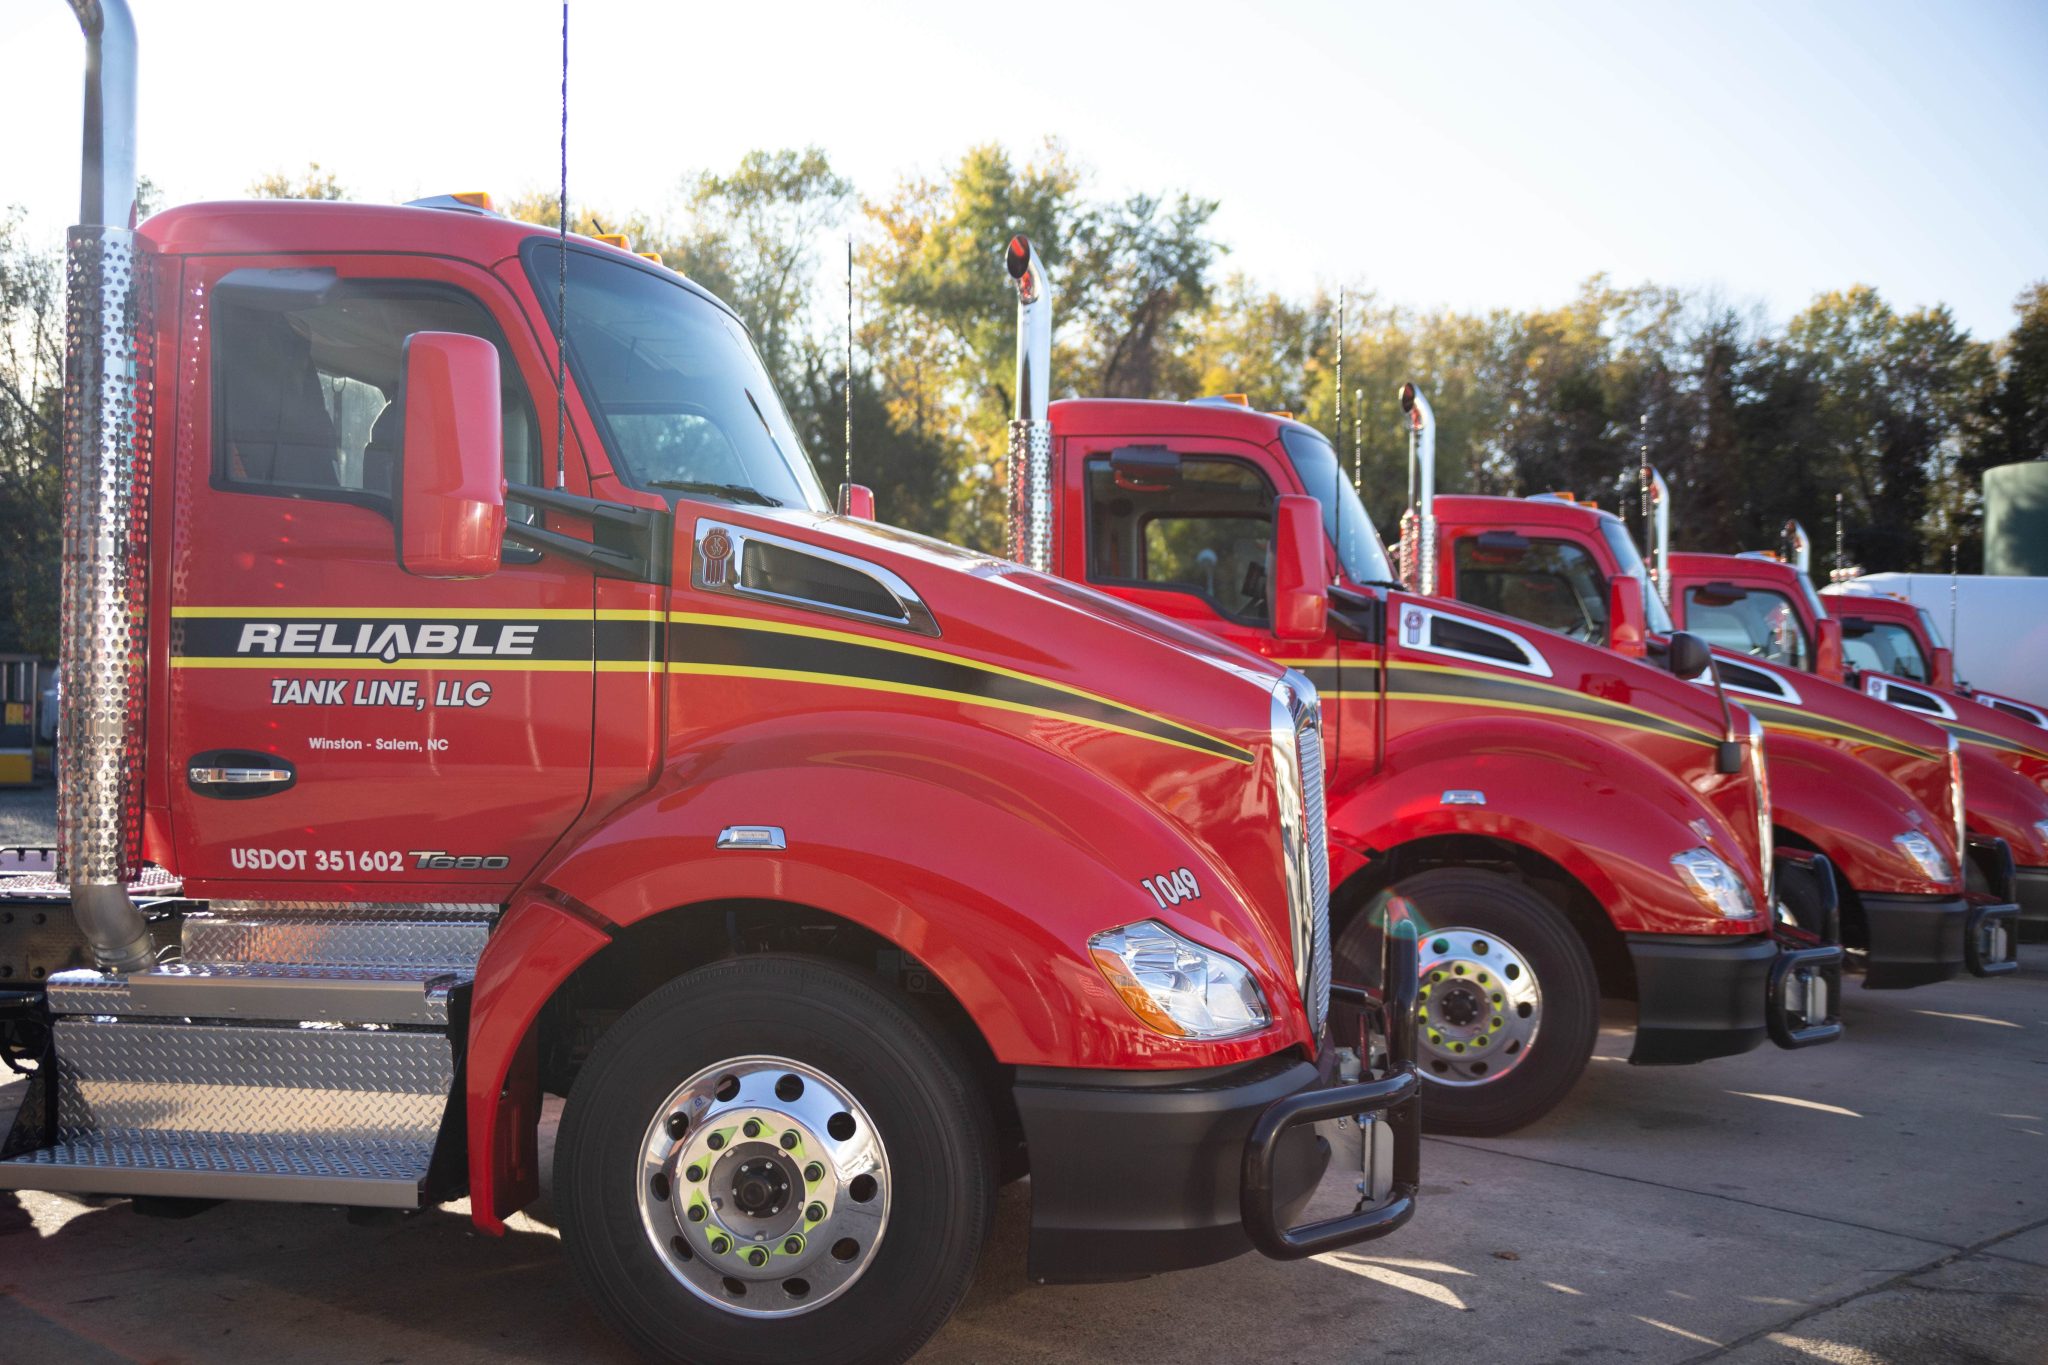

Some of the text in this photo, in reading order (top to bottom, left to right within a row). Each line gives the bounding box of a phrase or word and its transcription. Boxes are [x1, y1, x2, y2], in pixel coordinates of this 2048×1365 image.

[236, 623, 540, 657] RELIABLE
[271, 678, 492, 711] TANK LINE, LLC
[308, 737, 363, 750] Winston
[375, 737, 423, 753] Salem,
[427, 738, 449, 751] NC
[230, 848, 404, 872] USDOT 351602
[408, 850, 511, 869] T680
[1140, 866, 1201, 910] 1049
